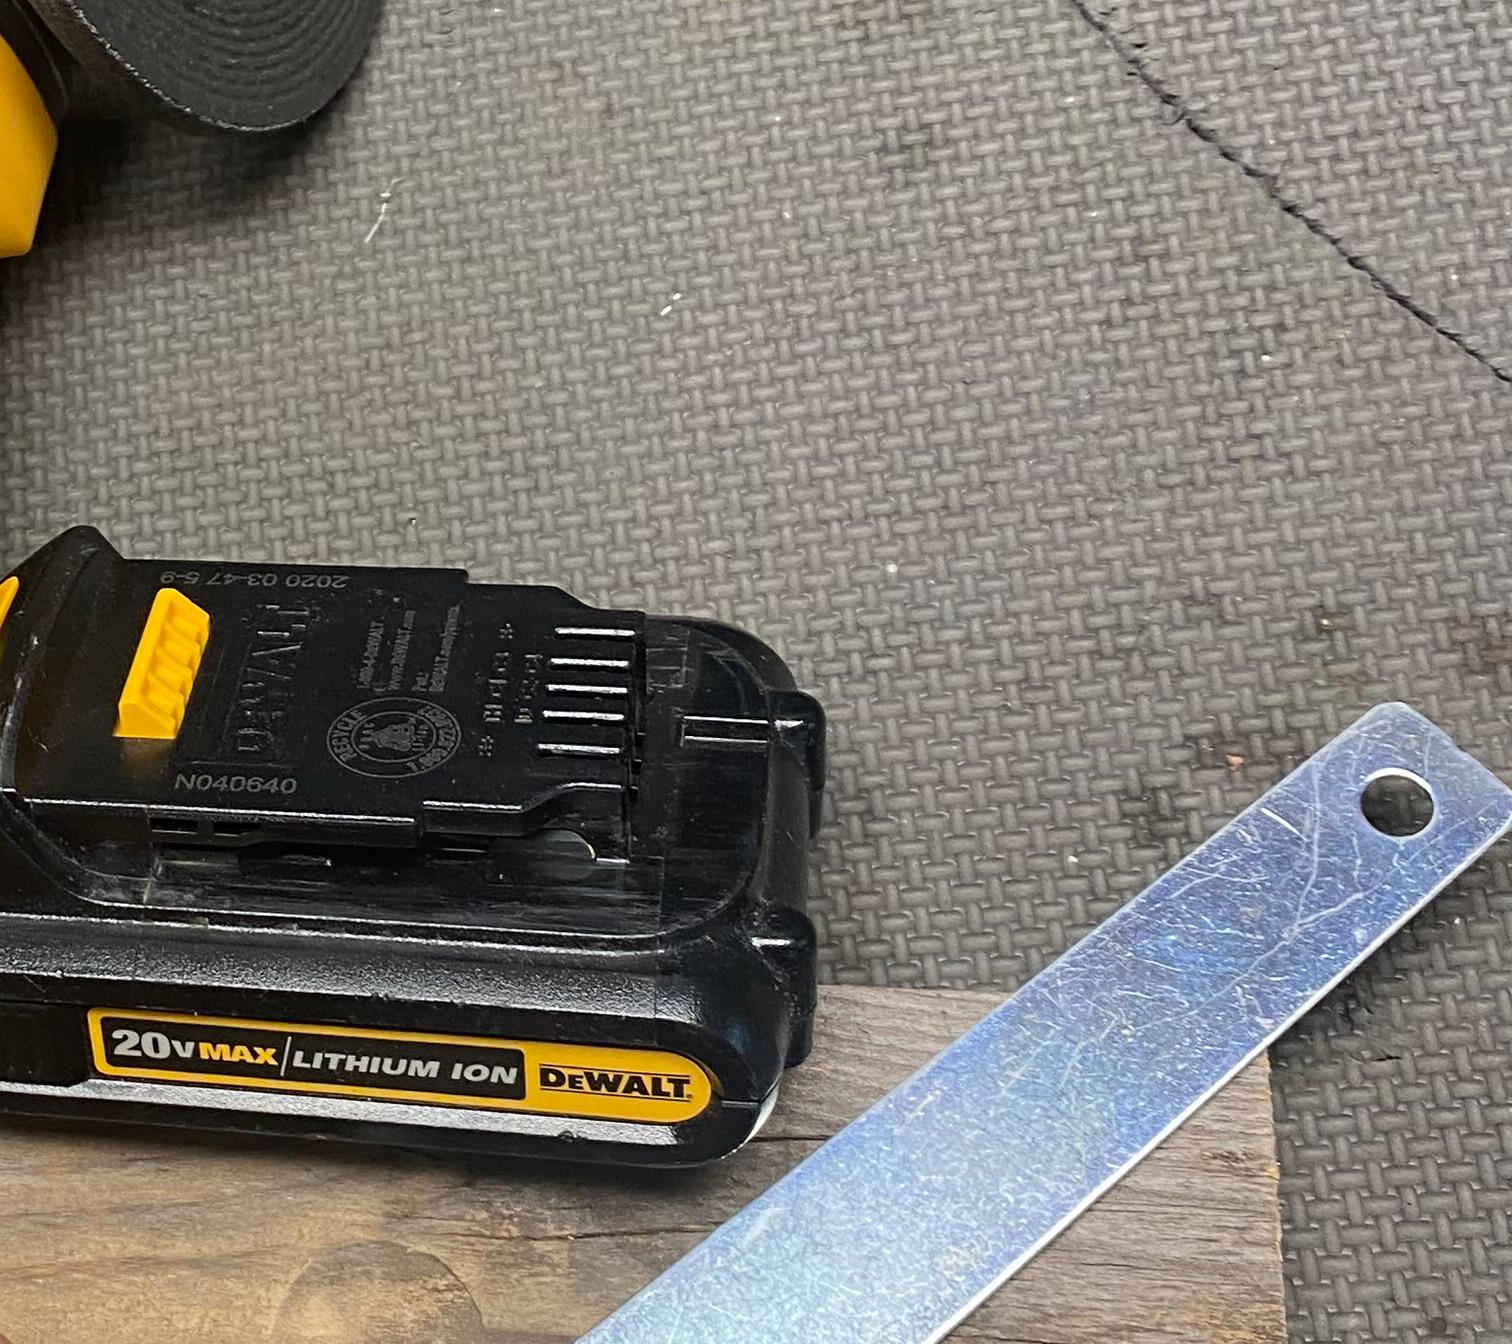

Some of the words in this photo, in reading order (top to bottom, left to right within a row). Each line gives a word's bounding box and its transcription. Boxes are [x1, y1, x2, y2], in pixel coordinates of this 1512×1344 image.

[174, 773, 297, 794] N040640
[198, 1042, 279, 1066] MAX
[292, 1049, 440, 1080] LITHIUM
[450, 1062, 518, 1085] ION
